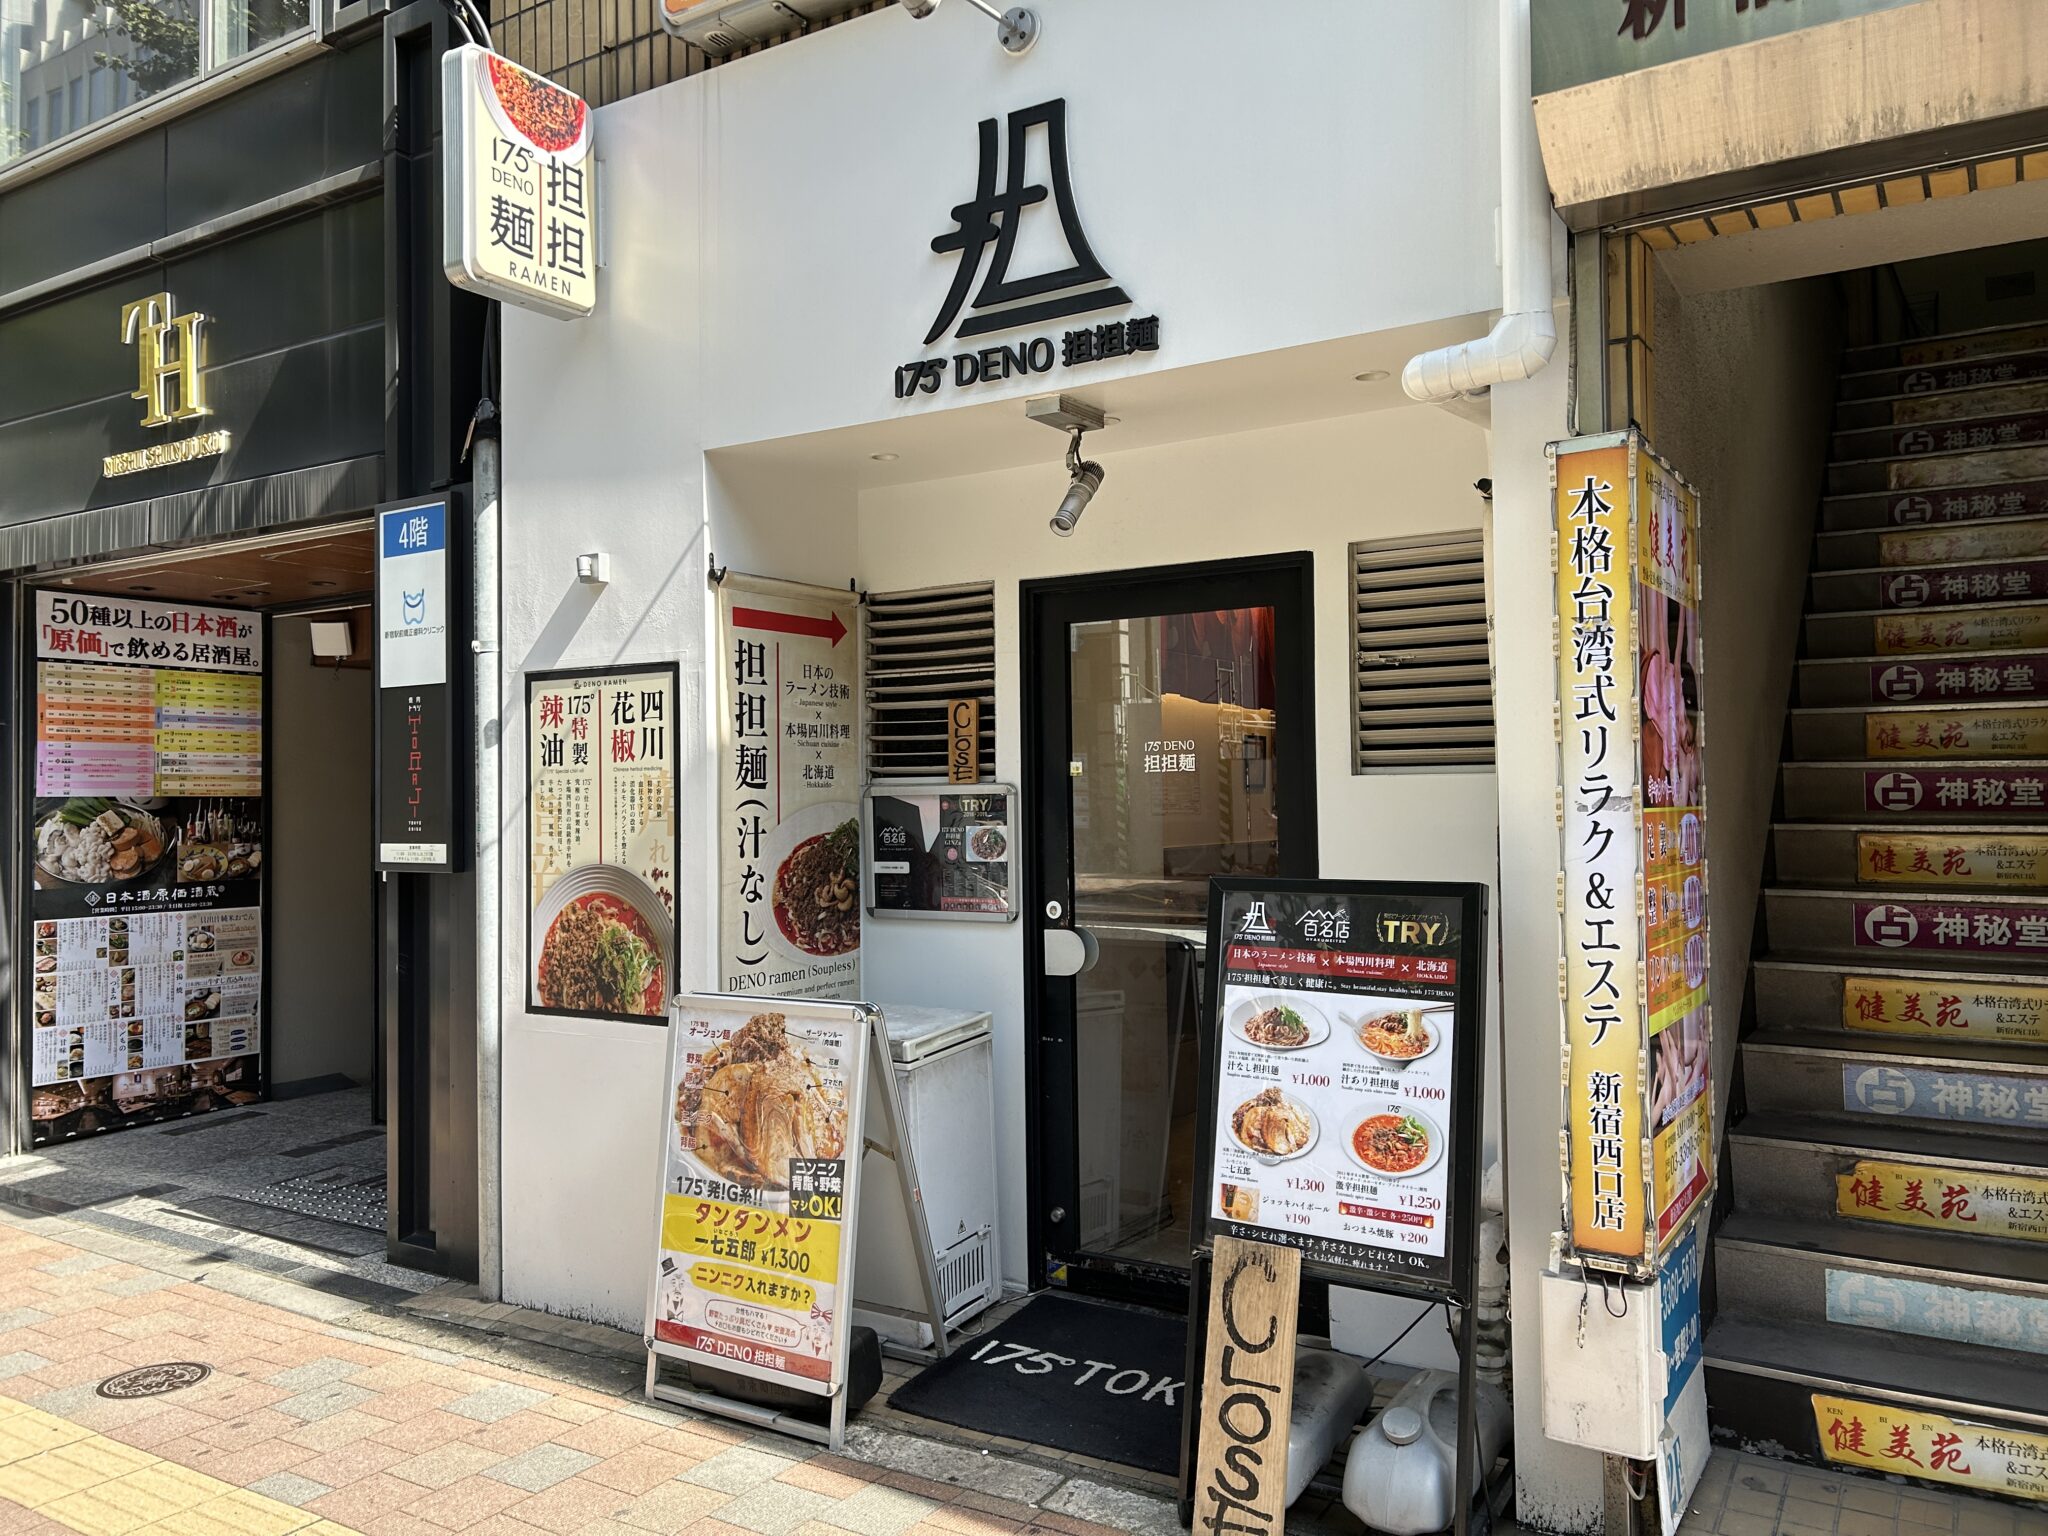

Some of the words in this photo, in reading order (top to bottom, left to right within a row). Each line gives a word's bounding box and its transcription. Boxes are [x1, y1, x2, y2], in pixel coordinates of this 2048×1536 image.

[492, 166, 534, 196] DENO
[509, 261, 571, 296] RAMEN
[953, 338, 1055, 387] DENO
[1061, 314, 1160, 367] 担担麺
[1944, 423, 2020, 450] 神秘堂
[1941, 491, 2027, 520] 神秘堂
[399, 515, 429, 548] 4階
[1940, 570, 2032, 600] 神秘堂
[51, 598, 253, 640] 50種以上の日本酒が
[42, 624, 260, 668] 「原価」で飲める居酒屋。
[802, 664, 834, 680] 日本の
[1935, 663, 2035, 695] 神秘堂
[785, 681, 850, 700] ラーメン技術
[540, 694, 564, 767] 辣油
[611, 691, 636, 763] 花椒
[640, 689, 664, 760] 四川
[785, 722, 850, 739] 本場四川料理
[953, 701, 973, 782] CLOSE
[1163, 739, 1195, 751] DENO
[802, 764, 835, 780] 北海道
[1144, 753, 1196, 773] 担担麺
[1935, 776, 2045, 808] 神秘堂
[962, 798, 989, 812] TRY
[1996, 859, 2036, 870] &エステ
[106, 884, 220, 904] 日本酒原価酒蔵
[1303, 919, 1350, 939] 百名店
[1383, 920, 1441, 945] TRY
[1932, 911, 2048, 947] 神秘堂
[1233, 948, 1316, 964] 日本のラーメン技術
[1335, 955, 1395, 969] 本場四川料理
[1416, 960, 1448, 973] 北海道
[729, 971, 766, 992] DENO
[769, 969, 806, 985] ramen
[808, 958, 856, 978] (Soupless)
[804, 984, 816, 994] and
[817, 982, 836, 993] perfect
[837, 979, 855, 987] ramen
[1855, 990, 1969, 1028] 健美苑
[1996, 1013, 2041, 1026] &エステ
[689, 1026, 731, 1040] オーション麺
[806, 1029, 843, 1038] ザージャンルー
[686, 1052, 703, 1063] 野菜
[1227, 1060, 1280, 1076] 汁なし担担麺
[823, 1078, 843, 1087] ゴマだれ
[1292, 1073, 1330, 1087] ¥1,000
[1341, 1073, 1400, 1090] 汁あり担担麺
[1404, 1086, 1445, 1100] ¥1,000
[1587, 1071, 1625, 1232] 新宿西口店
[795, 1162, 838, 1177] ニンニク
[1221, 1164, 1251, 1176] 一七五郎
[791, 1175, 841, 1193] 背脂・野菜
[1286, 1177, 1325, 1193] ¥1,300
[1335, 1180, 1378, 1196] 激辛担担麺
[1262, 1195, 1330, 1213] ジョッキハイボール
[1399, 1194, 1441, 1210] ¥1,250
[1850, 1175, 1978, 1222] 健美苑
[695, 1202, 812, 1243] タンタンメン
[1286, 1213, 1311, 1225] ¥190
[1343, 1222, 1394, 1239] おつまみ焼豚
[1400, 1232, 1428, 1245] ¥200
[694, 1234, 757, 1262] 一七五郎
[761, 1246, 810, 1273] ¥1,300
[717, 1339, 752, 1362] DENO
[754, 1349, 785, 1370] 担担麺
[1826, 1406, 1844, 1416] KEN
[1879, 1416, 1888, 1424] BI
[1922, 1424, 1934, 1432] EN
[1828, 1416, 1971, 1475] 健美苑
